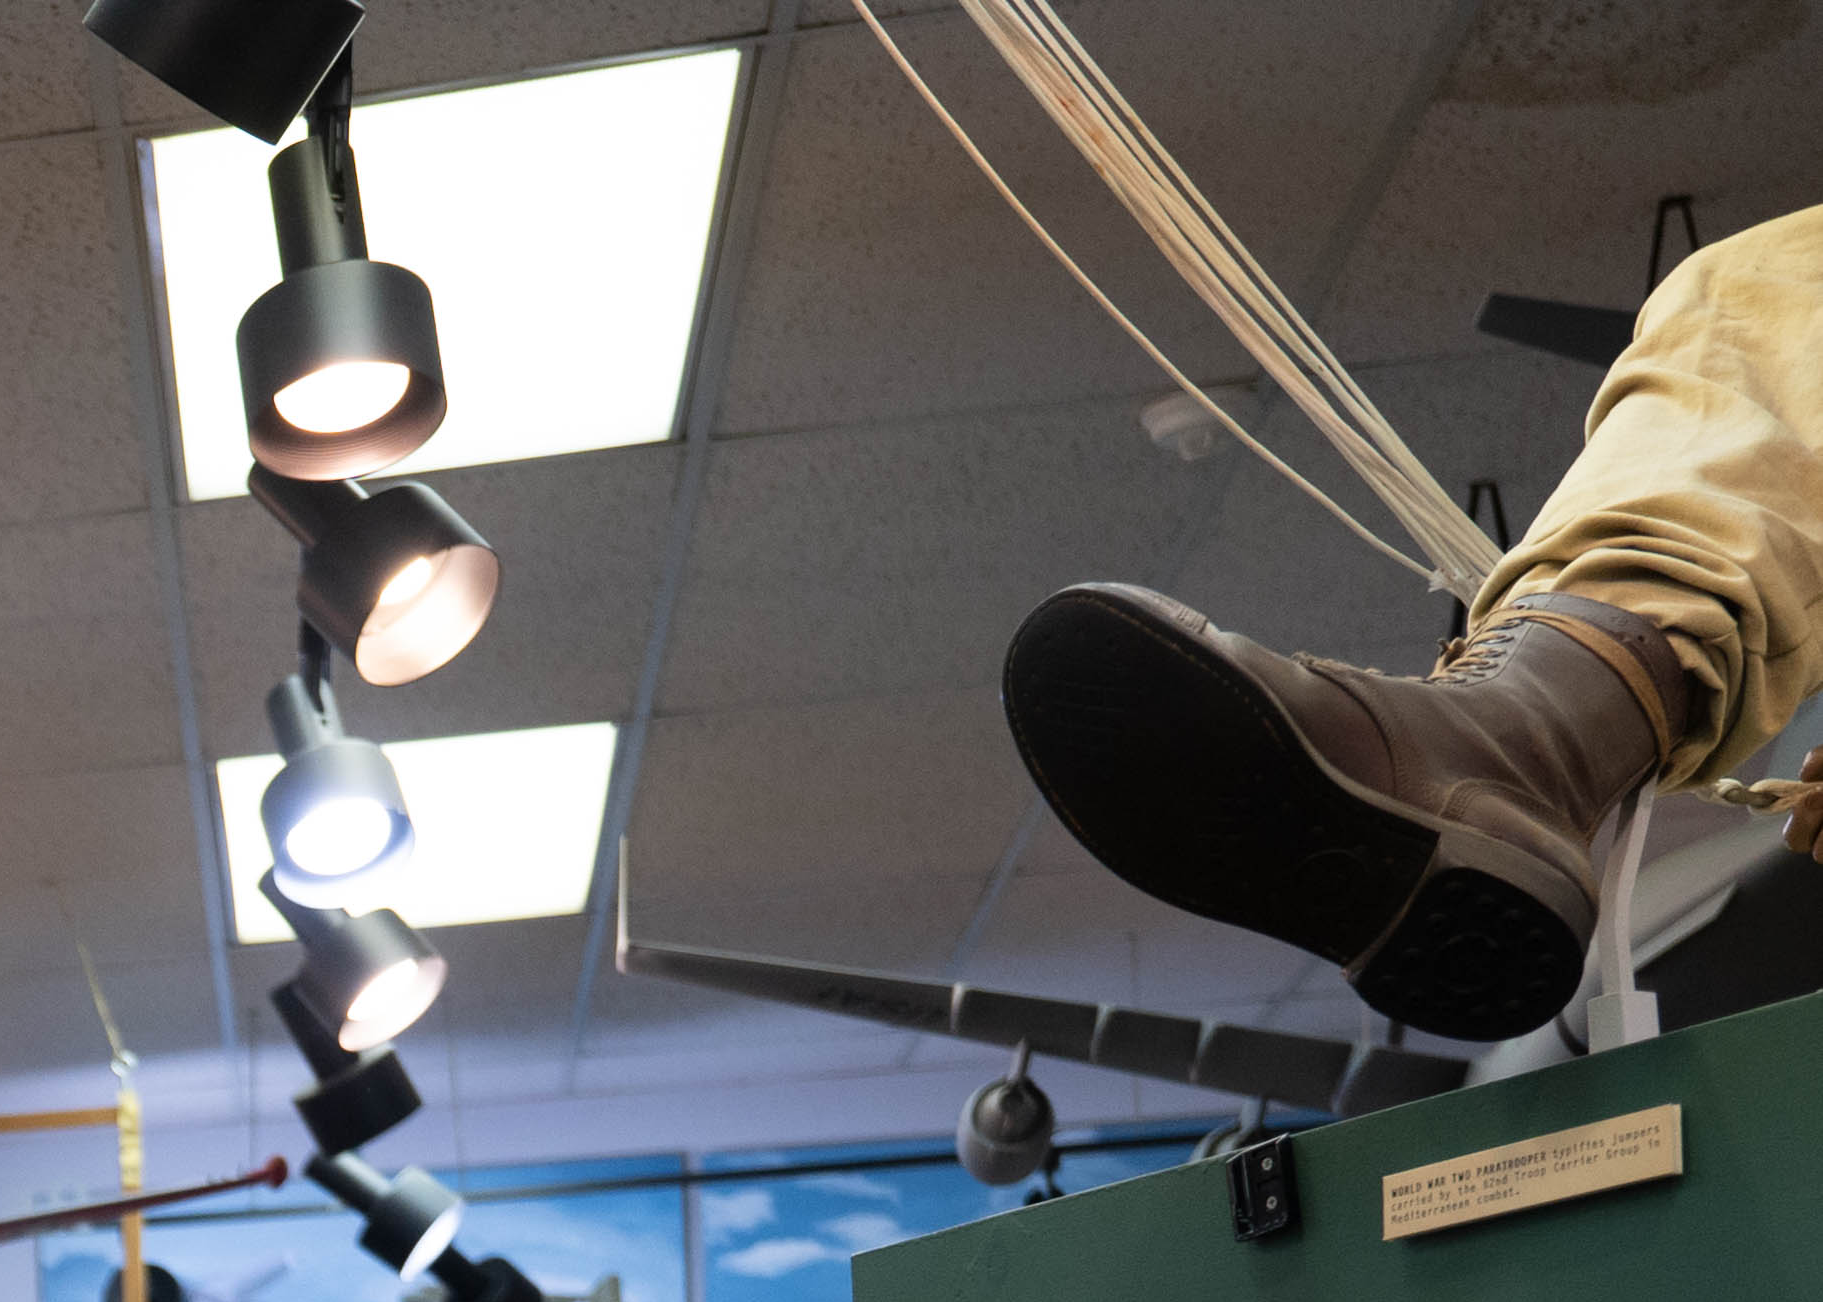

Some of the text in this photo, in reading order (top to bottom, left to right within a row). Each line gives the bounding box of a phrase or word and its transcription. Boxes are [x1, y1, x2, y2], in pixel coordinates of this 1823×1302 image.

[1390, 1192, 1433, 1212] carried
[1439, 1189, 1451, 1202] by
[1457, 1183, 1476, 1196] the
[1514, 1166, 1547, 1182] Troop
[1554, 1153, 1599, 1173] Carrier
[1605, 1144, 1640, 1161] Group
[1647, 1138, 1660, 1150] in
[1391, 1124, 1660, 1198] WORLD WAR TWO PARATROOPER typifies jumpers
[1390, 1186, 1520, 1224] Mediterranean combat.
